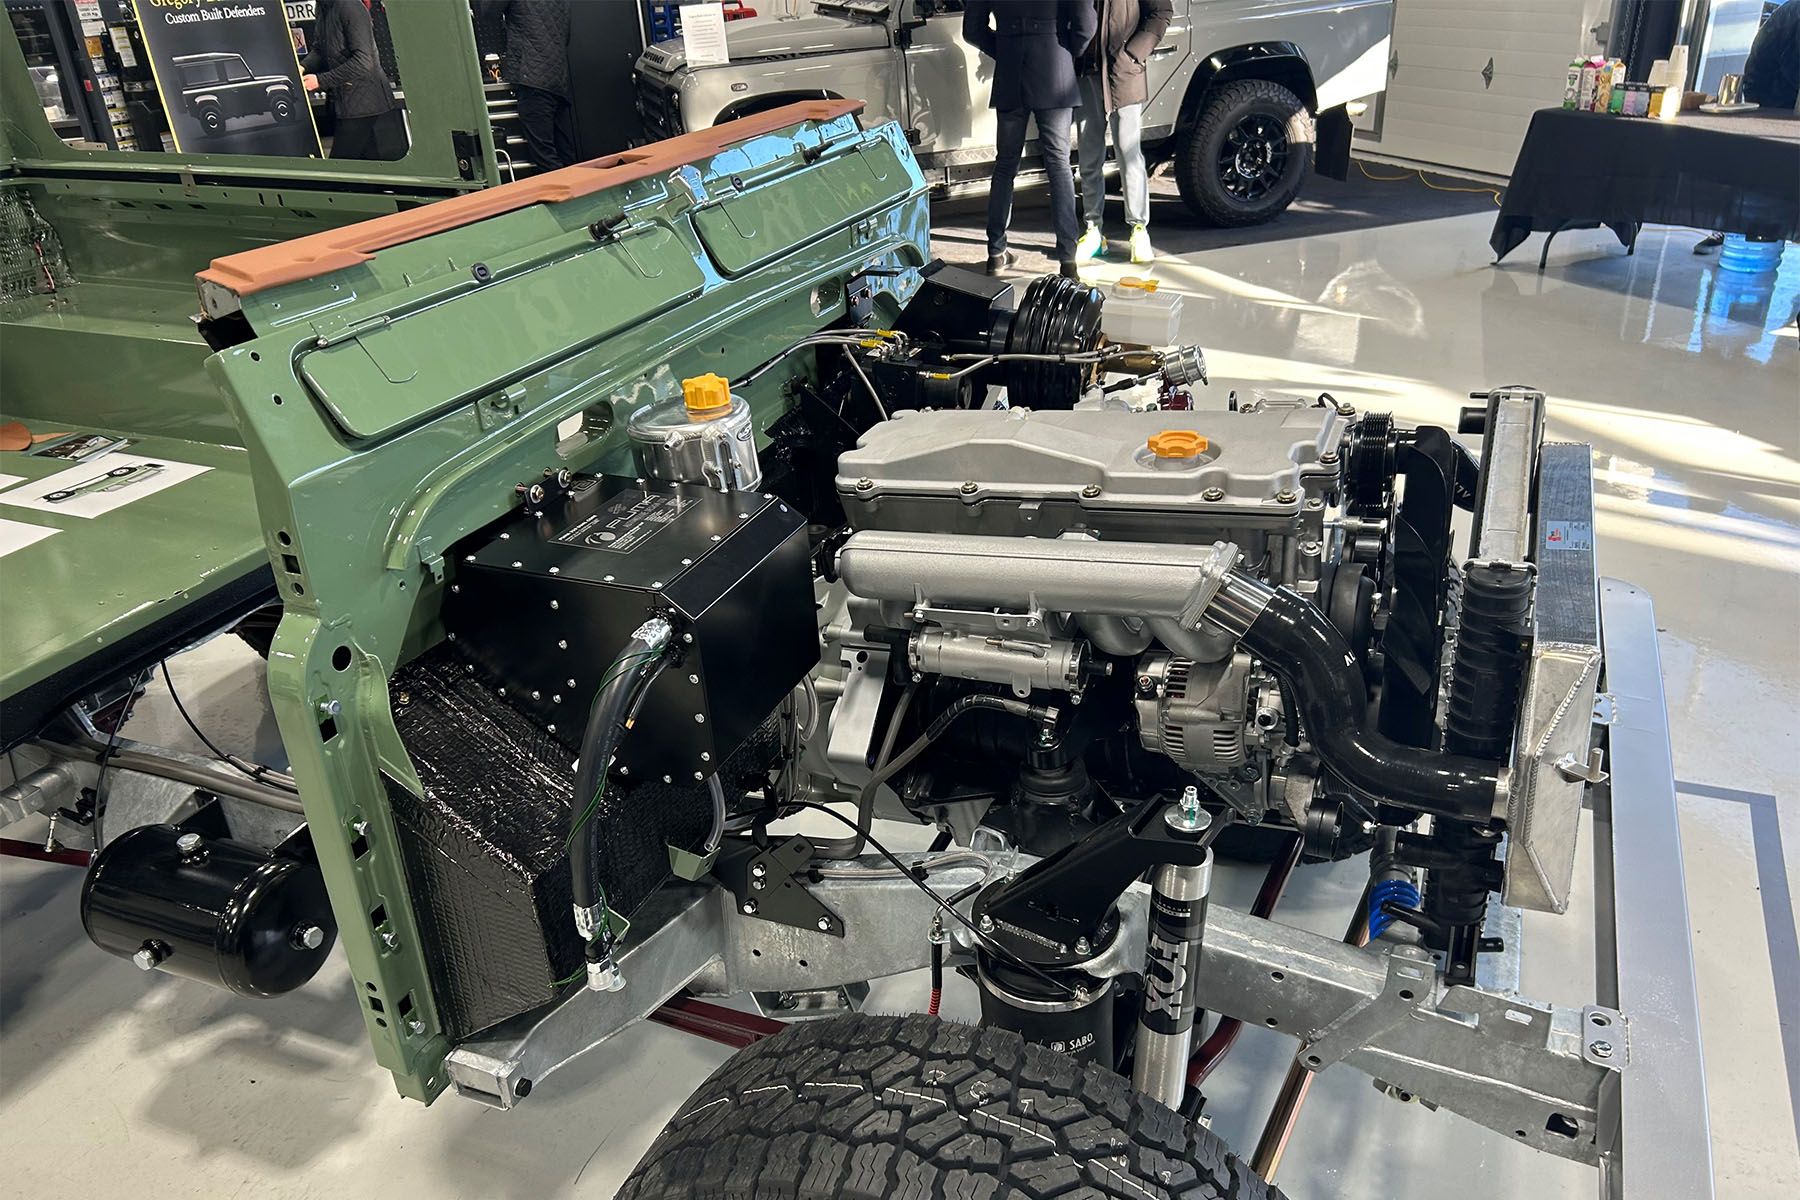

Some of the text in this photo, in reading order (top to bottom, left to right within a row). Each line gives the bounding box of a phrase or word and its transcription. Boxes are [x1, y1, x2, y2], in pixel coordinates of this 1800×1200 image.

[165, 4, 266, 25] Custom Built Defenders
[1145, 931, 1189, 1020] FOX
[1069, 1032, 1093, 1050] SABO
